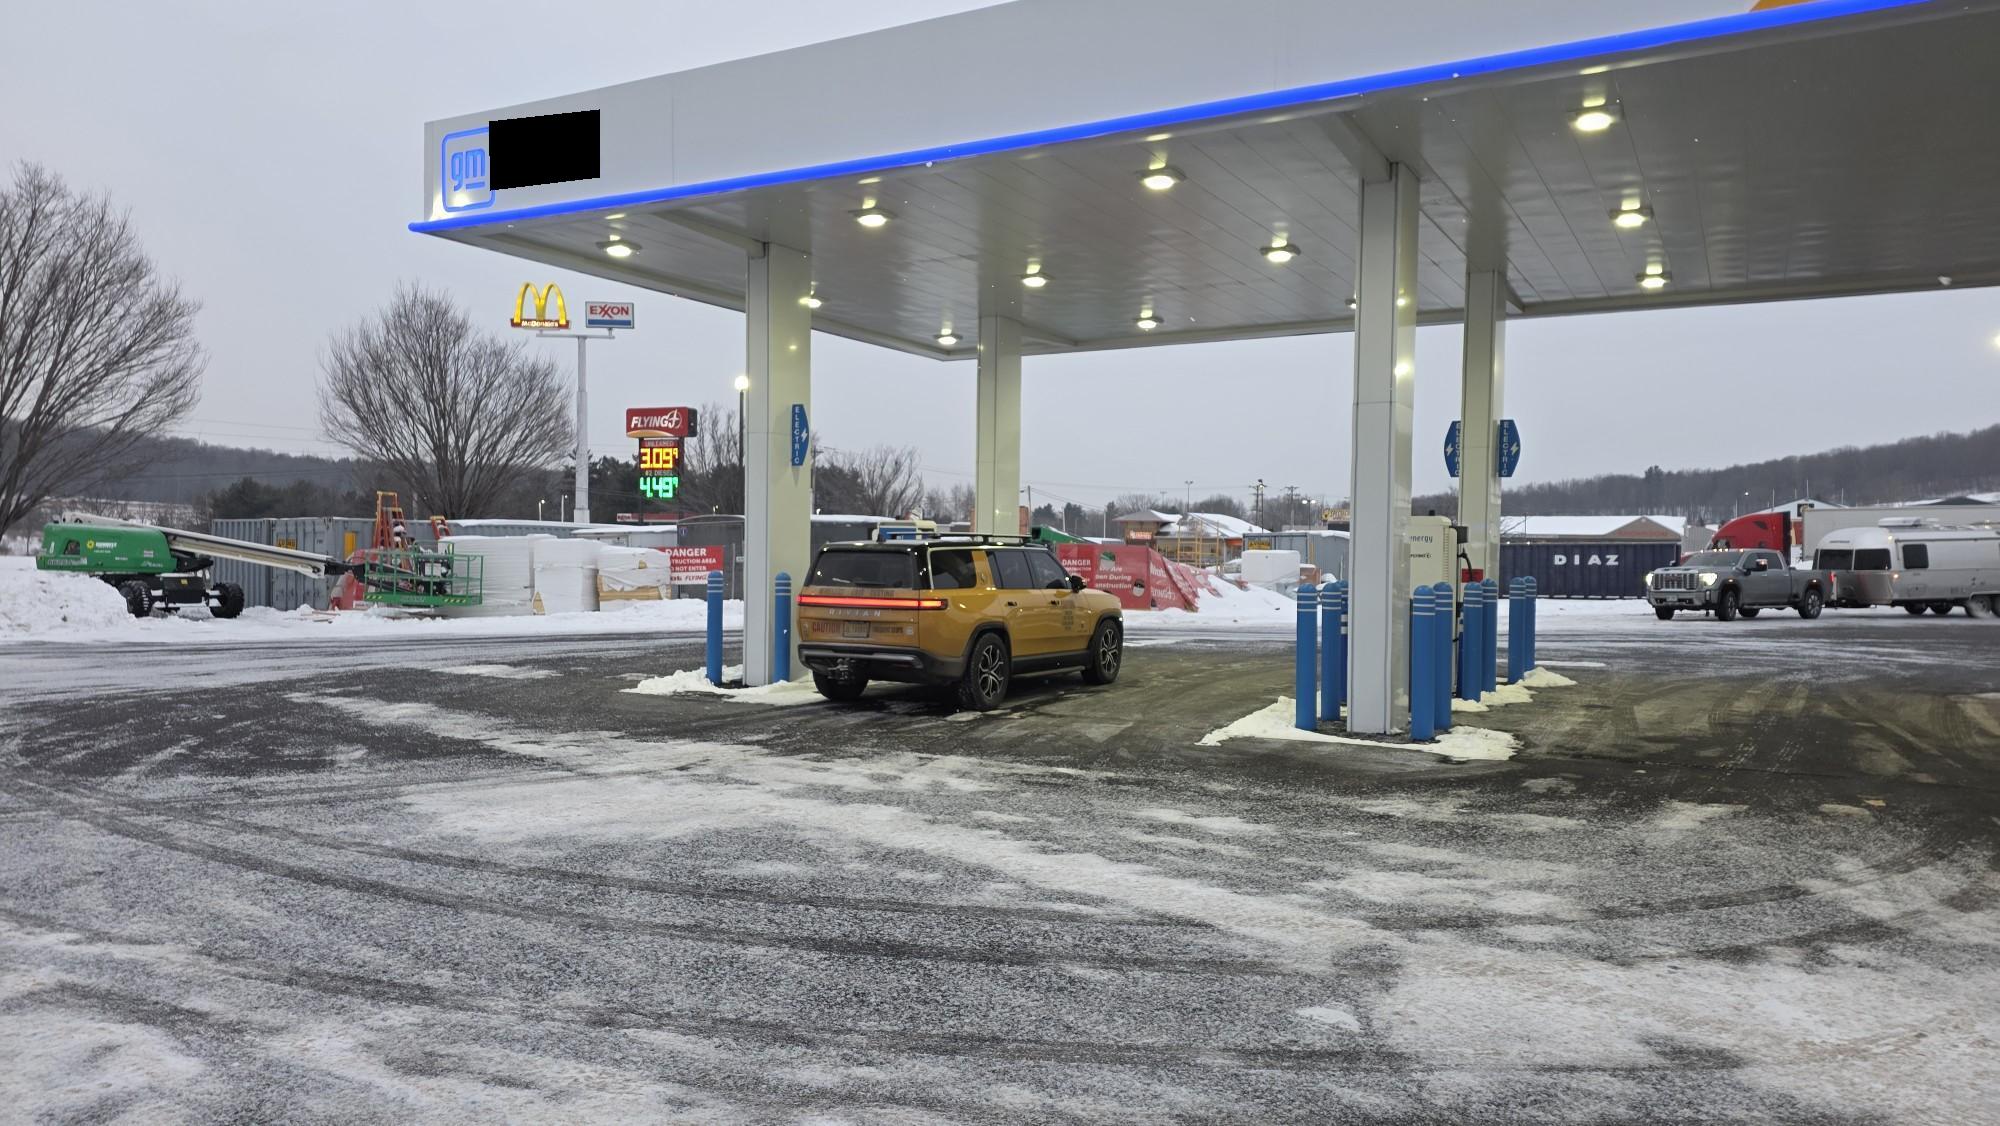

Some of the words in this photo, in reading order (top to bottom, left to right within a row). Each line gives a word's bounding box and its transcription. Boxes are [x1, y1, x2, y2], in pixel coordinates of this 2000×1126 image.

[451, 148, 485, 192] gm
[589, 304, 629, 319] EXXON
[665, 548, 707, 557] DANGER
[1554, 554, 1619, 566] DIAZ
[829, 608, 881, 617] RIVIAN
